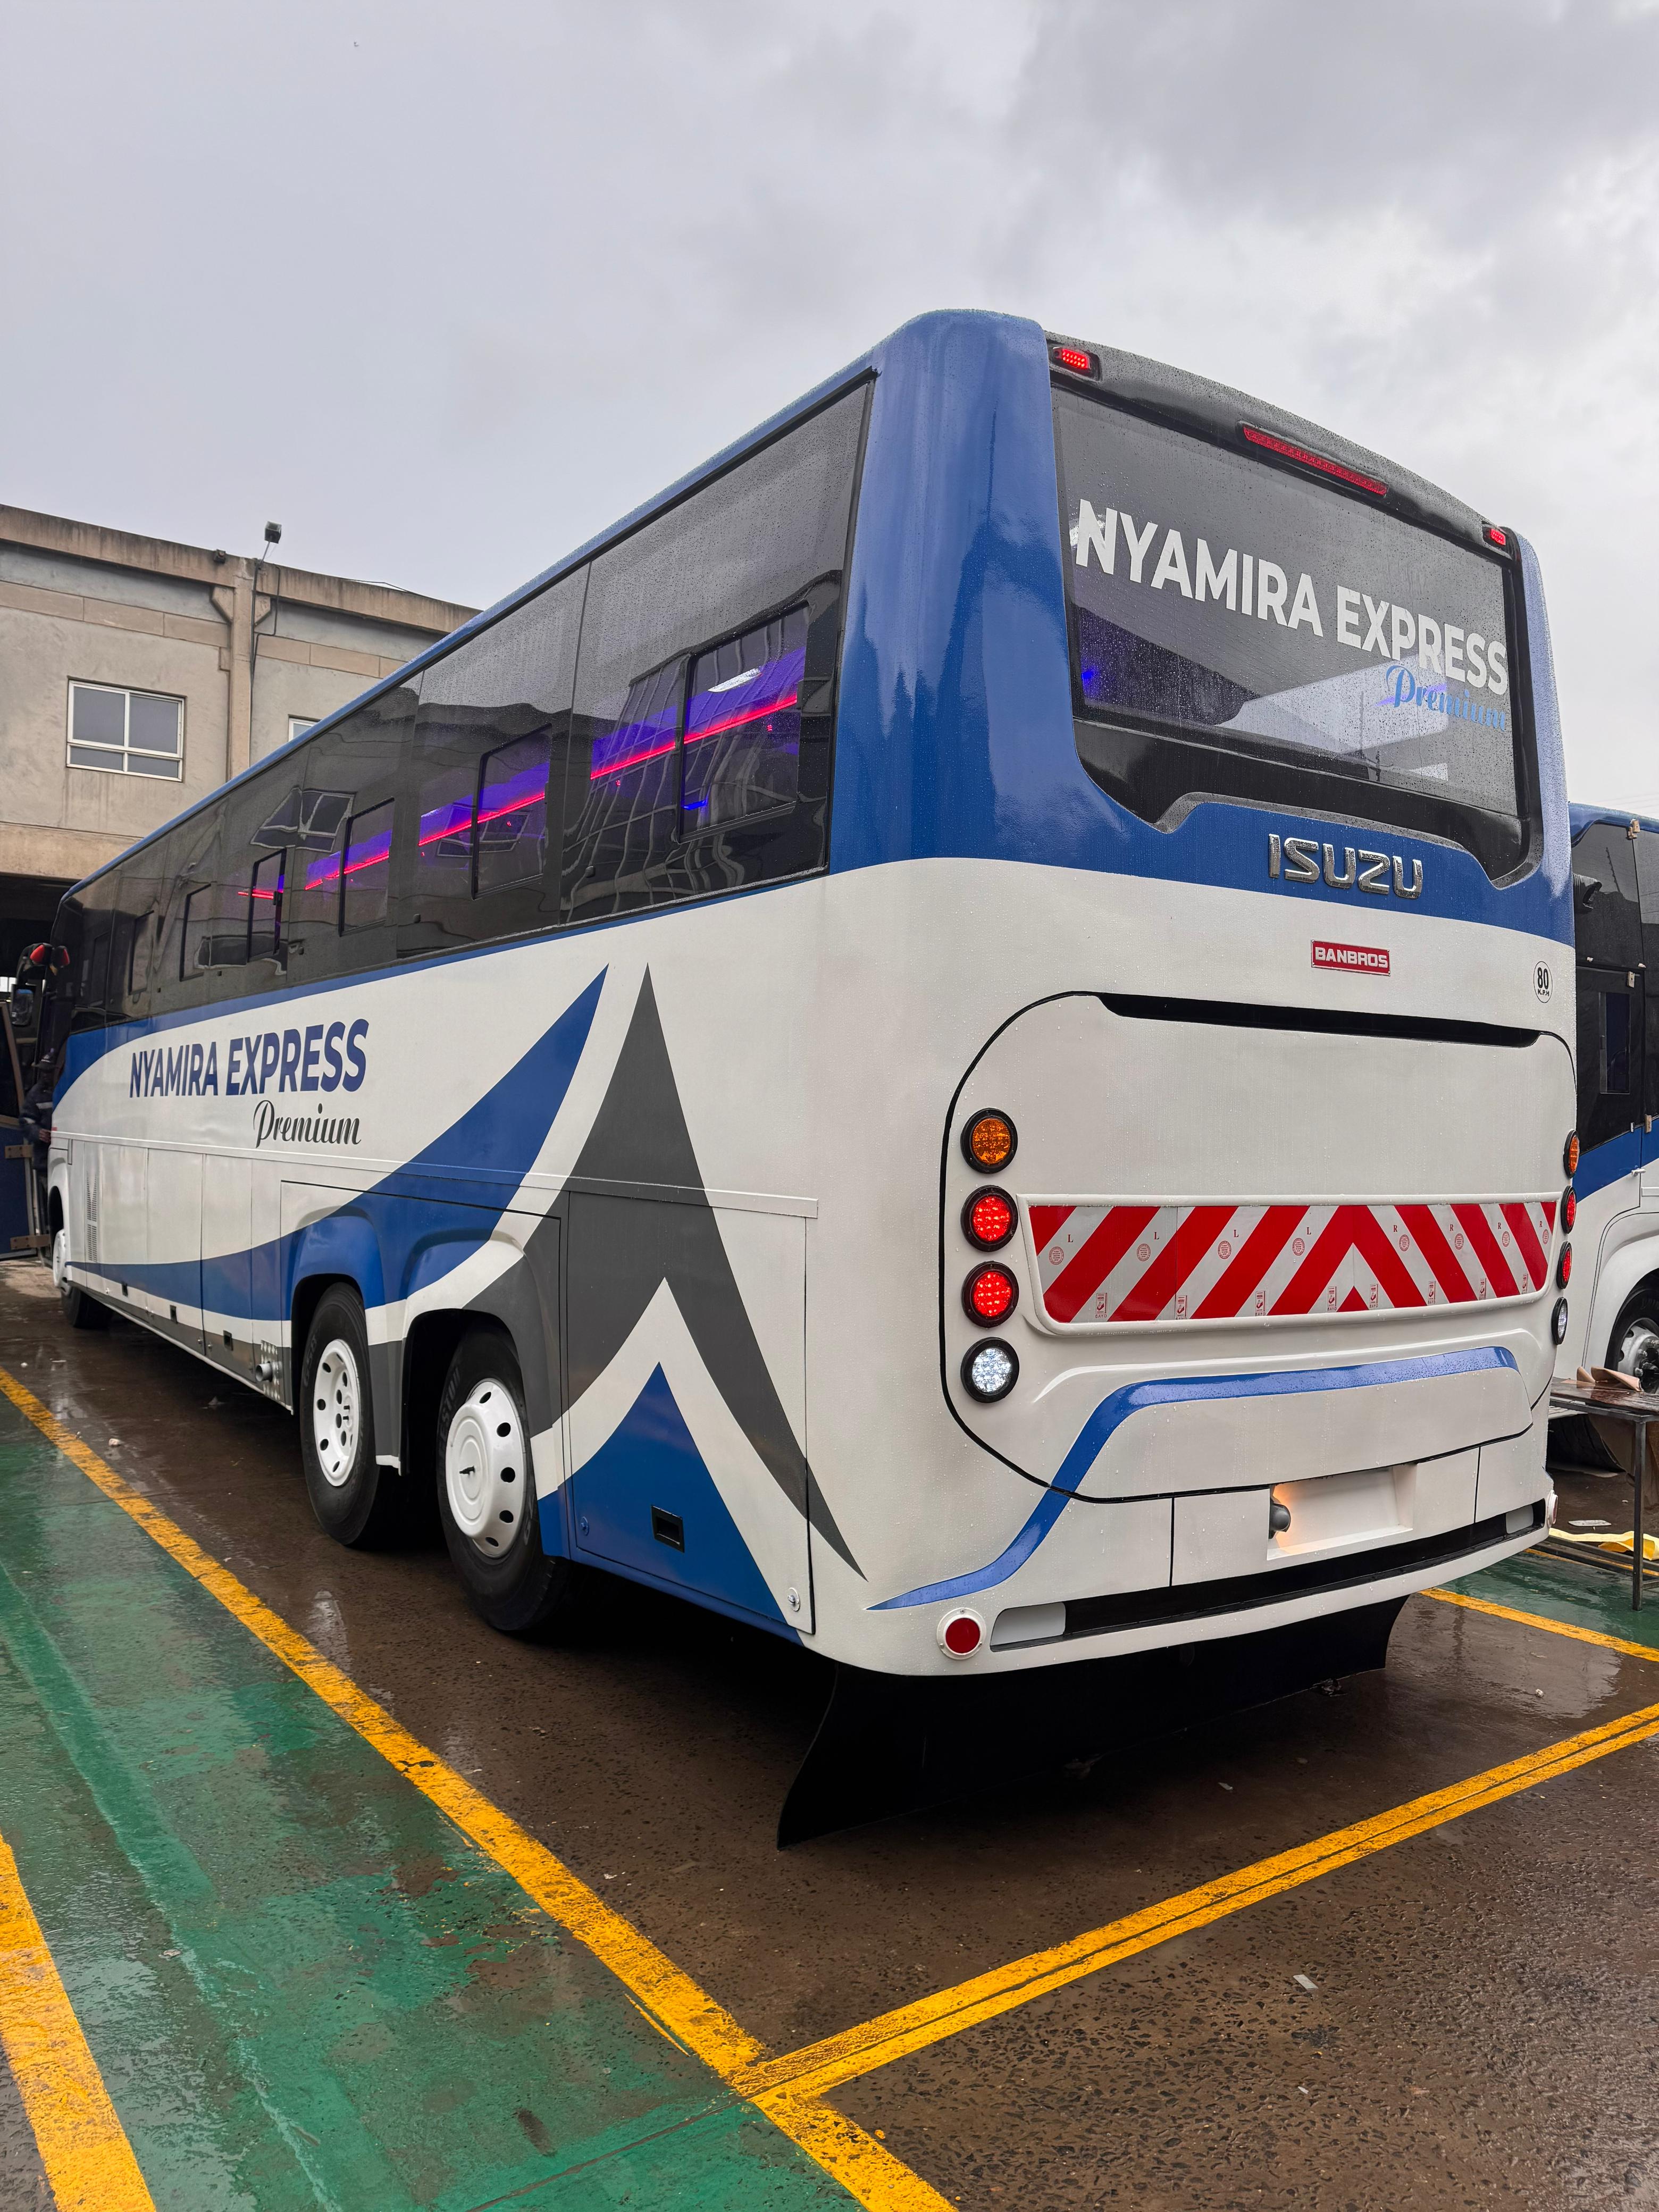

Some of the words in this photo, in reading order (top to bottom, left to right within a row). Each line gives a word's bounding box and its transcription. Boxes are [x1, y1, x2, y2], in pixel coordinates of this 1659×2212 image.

[1075, 499, 1323, 637] NYAMIRA
[1337, 585, 1508, 696] EXPRESS
[1386, 665, 1505, 731] Premium
[1269, 833, 1422, 899] ISUZU
[1315, 946, 1388, 968] BANBROS
[1537, 967, 1549, 990] 80
[129, 1041, 218, 1098] NYAMIRA
[225, 1019, 370, 1096] EXPRESS
[253, 1100, 362, 1149] Premium
[1067, 1234, 1074, 1243] L
